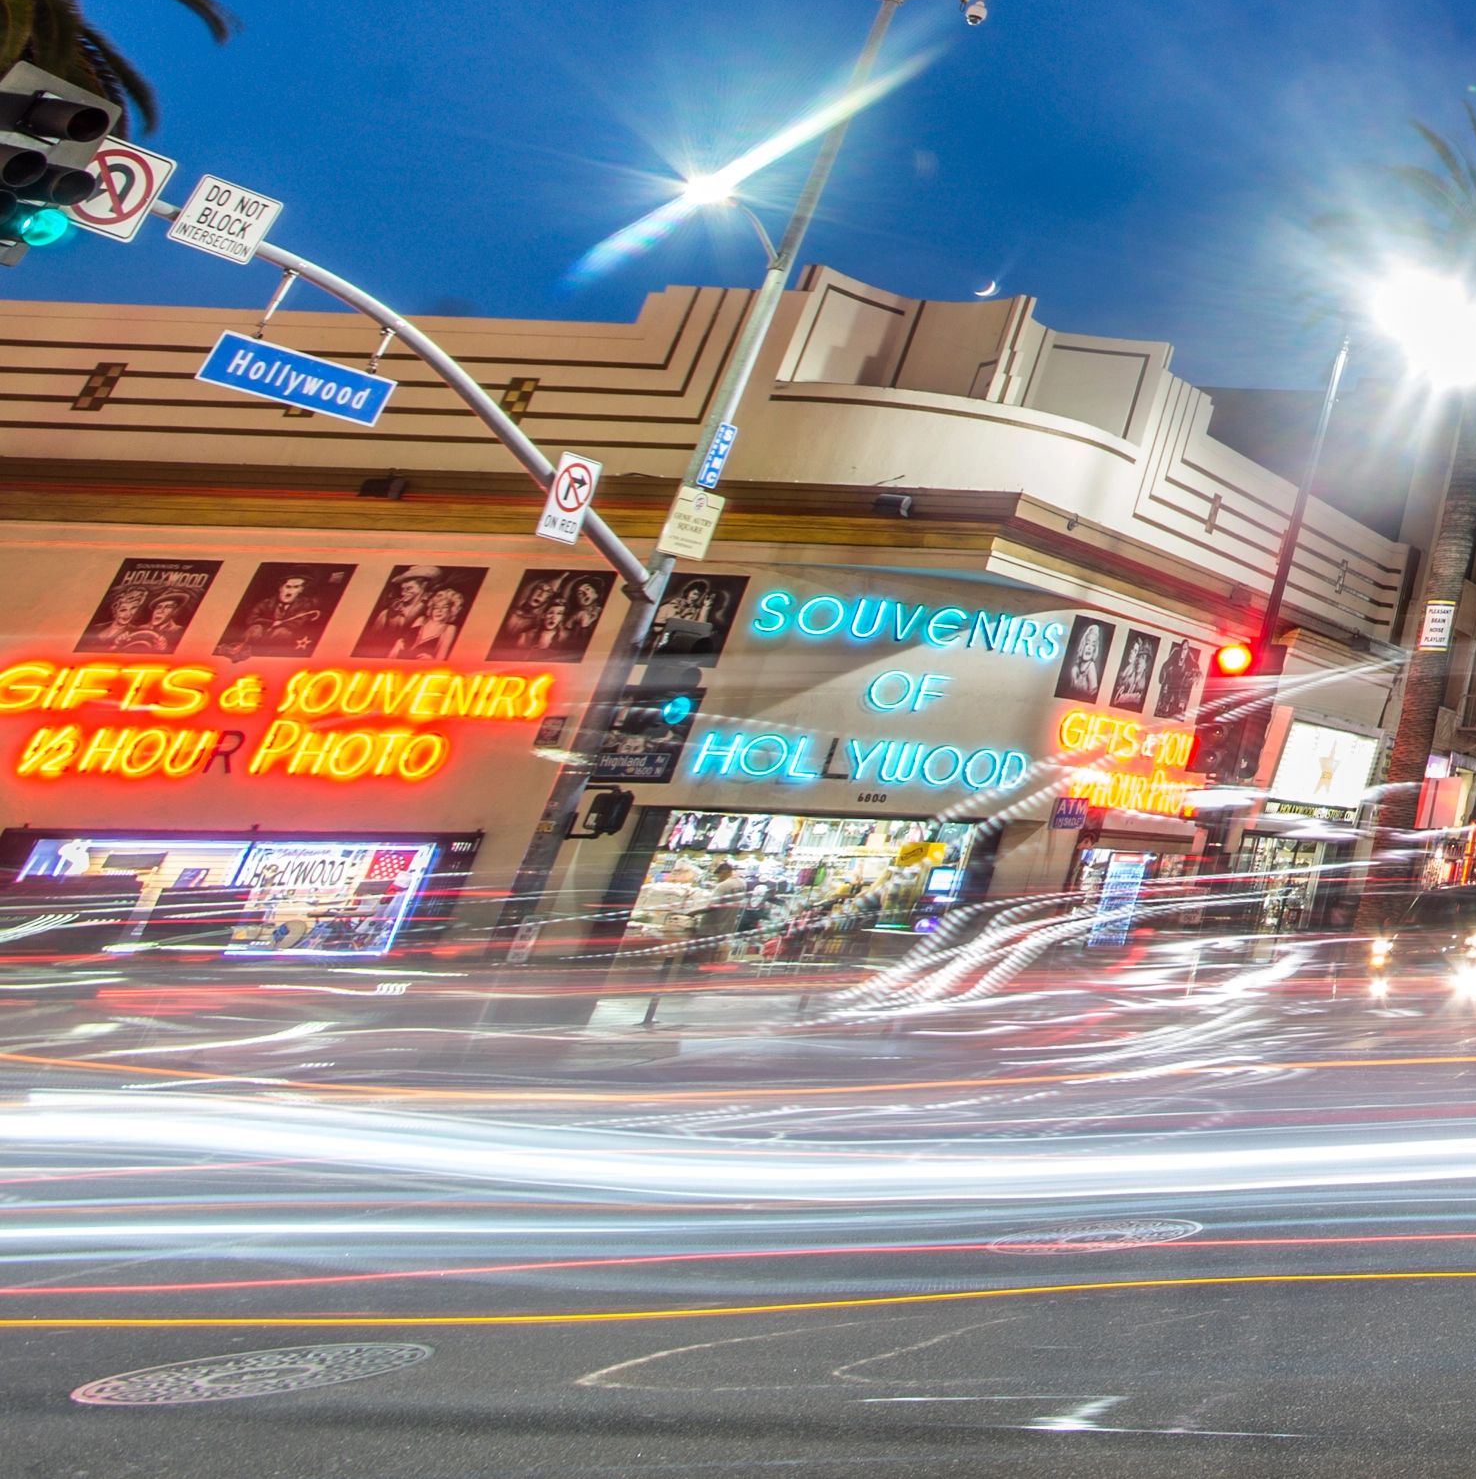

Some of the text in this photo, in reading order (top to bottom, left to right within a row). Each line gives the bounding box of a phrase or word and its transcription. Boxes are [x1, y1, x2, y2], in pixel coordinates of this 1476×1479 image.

[205, 185, 270, 221] DO NOT
[175, 222, 252, 258] INTERSECTION
[196, 207, 252, 240] BLOCK
[226, 349, 373, 410] Hollywood
[543, 514, 578, 535] ON RED
[121, 570, 210, 589] HOLLYWOOD
[754, 591, 1064, 662] SOUVENIRS
[0, 662, 555, 720] GIFTS & SOUVENIRS
[866, 669, 955, 714] OF
[78, 726, 246, 776] HOUR
[249, 719, 450, 778] PHOTO
[1059, 711, 1141, 758] GIFTS
[600, 756, 647, 769] Highland
[634, 766, 653, 775] 1600
[693, 731, 1028, 790] HOLLYWOOD
[857, 792, 887, 804] 6800
[1056, 800, 1087, 815] ATM
[249, 858, 346, 889] HOLLYWOOD
